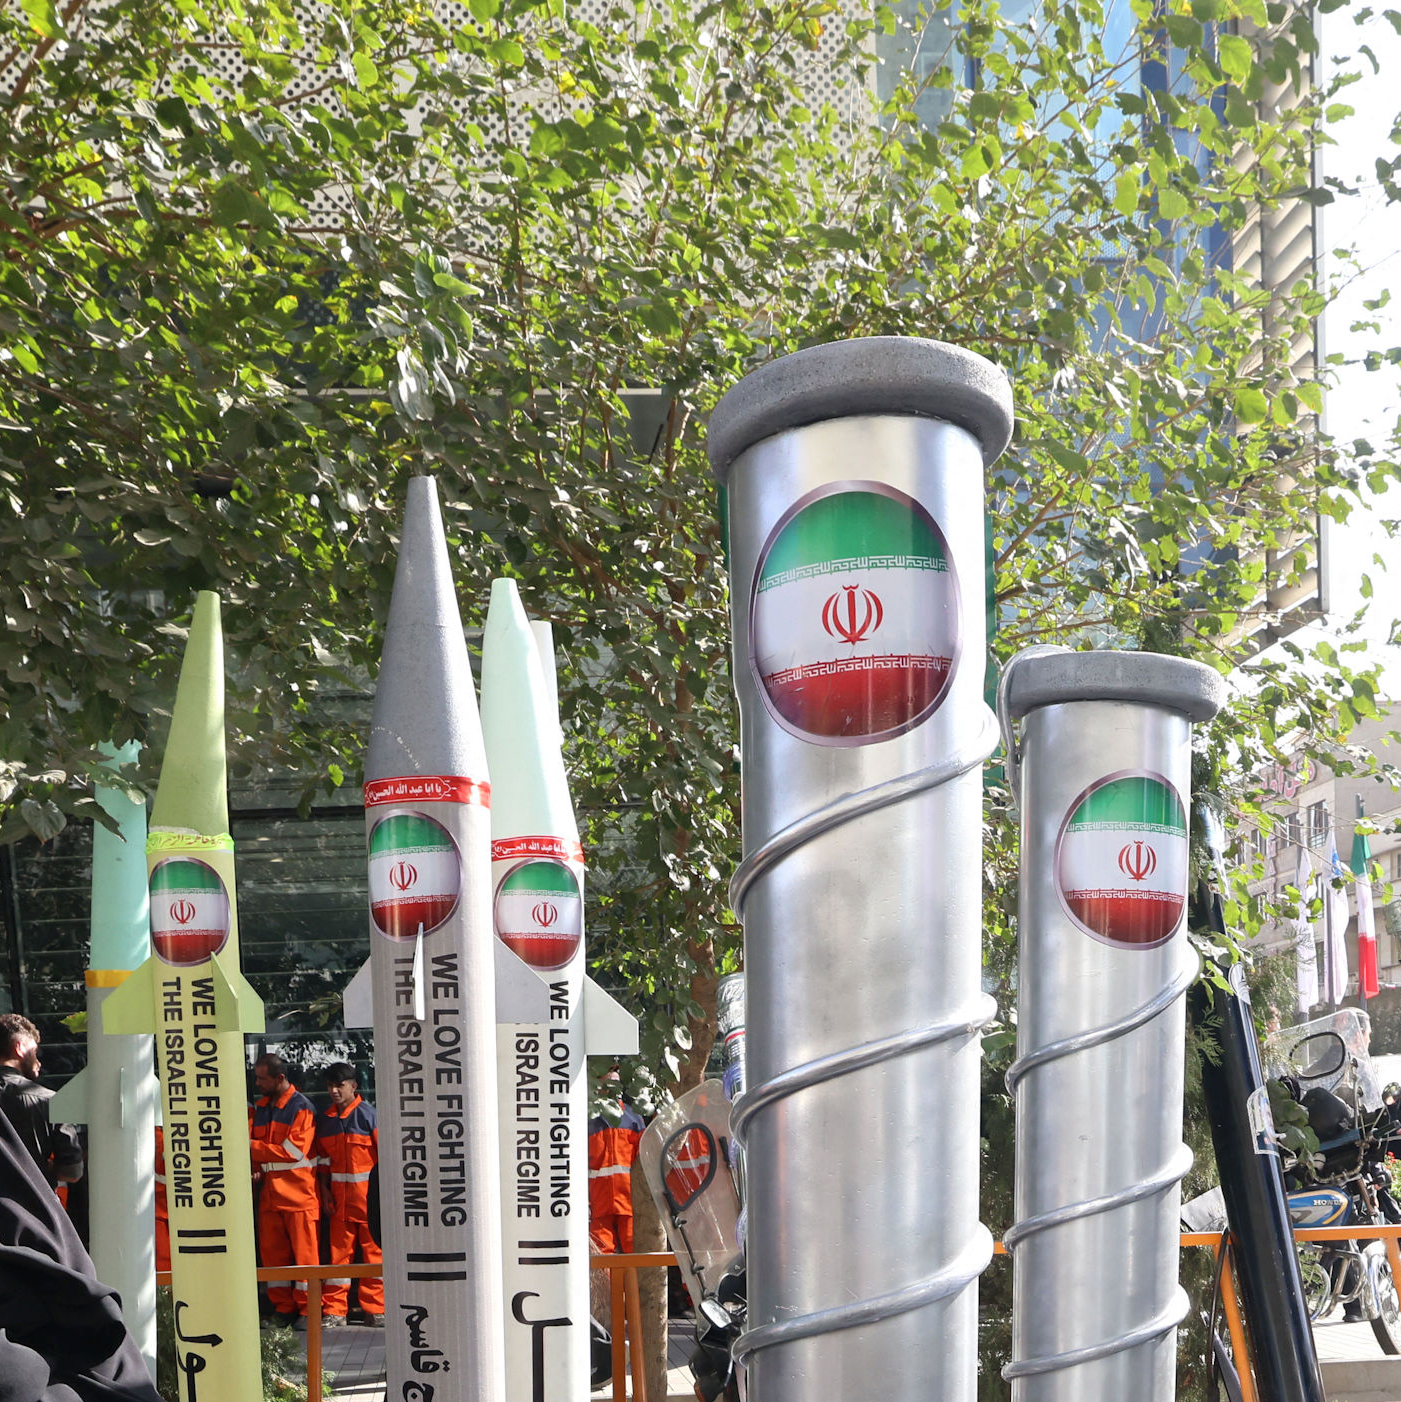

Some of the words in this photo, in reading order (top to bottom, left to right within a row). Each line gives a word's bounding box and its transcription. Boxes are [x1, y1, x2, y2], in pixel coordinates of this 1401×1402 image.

[162, 976, 183, 1022] THE
[191, 977, 216, 1016] WE
[431, 953, 459, 999] WE
[549, 980, 569, 1020] WE
[165, 1029, 188, 1115] ISRAELI
[193, 1024, 220, 1088] LOVE
[396, 1014, 425, 1118] ISRAELI
[433, 1009, 462, 1086] LOVE
[515, 1032, 540, 1122] ISRAELI
[549, 1028, 570, 1094] LOVE
[170, 1123, 193, 1208] REGIME
[197, 1096, 226, 1208] FIGHTING
[401, 1126, 429, 1227] REGIME
[436, 1094, 467, 1227] FIGHTING
[516, 1130, 540, 1218] REGIME
[549, 1103, 571, 1218] FIGHTING
[400, 1304, 450, 1373] قاسم
